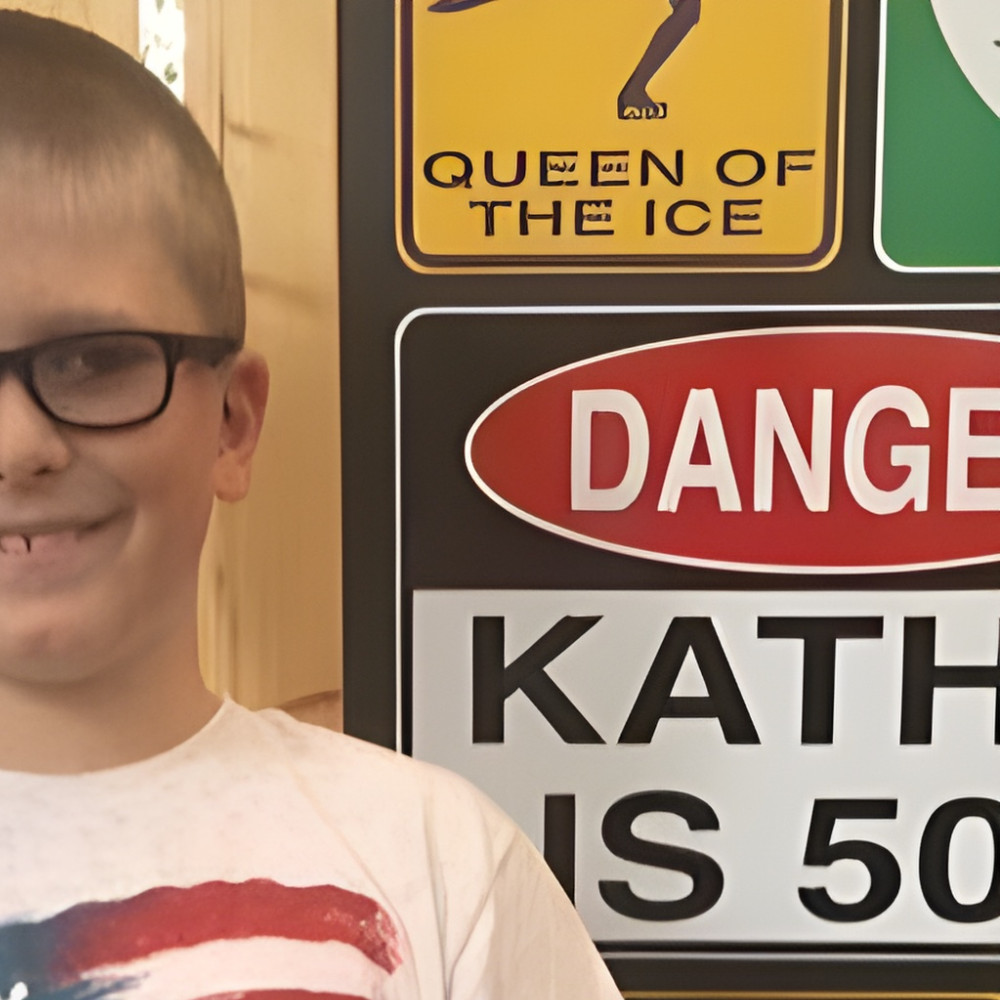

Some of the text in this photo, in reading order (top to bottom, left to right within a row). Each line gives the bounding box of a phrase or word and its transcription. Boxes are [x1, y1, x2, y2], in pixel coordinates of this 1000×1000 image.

[423, 149, 816, 189] QUEEN OF
[469, 199, 763, 237] THE ICE
[570, 384, 1000, 515] DANGE
[472, 614, 1000, 745] KATH
[543, 790, 1000, 924] IS 50
